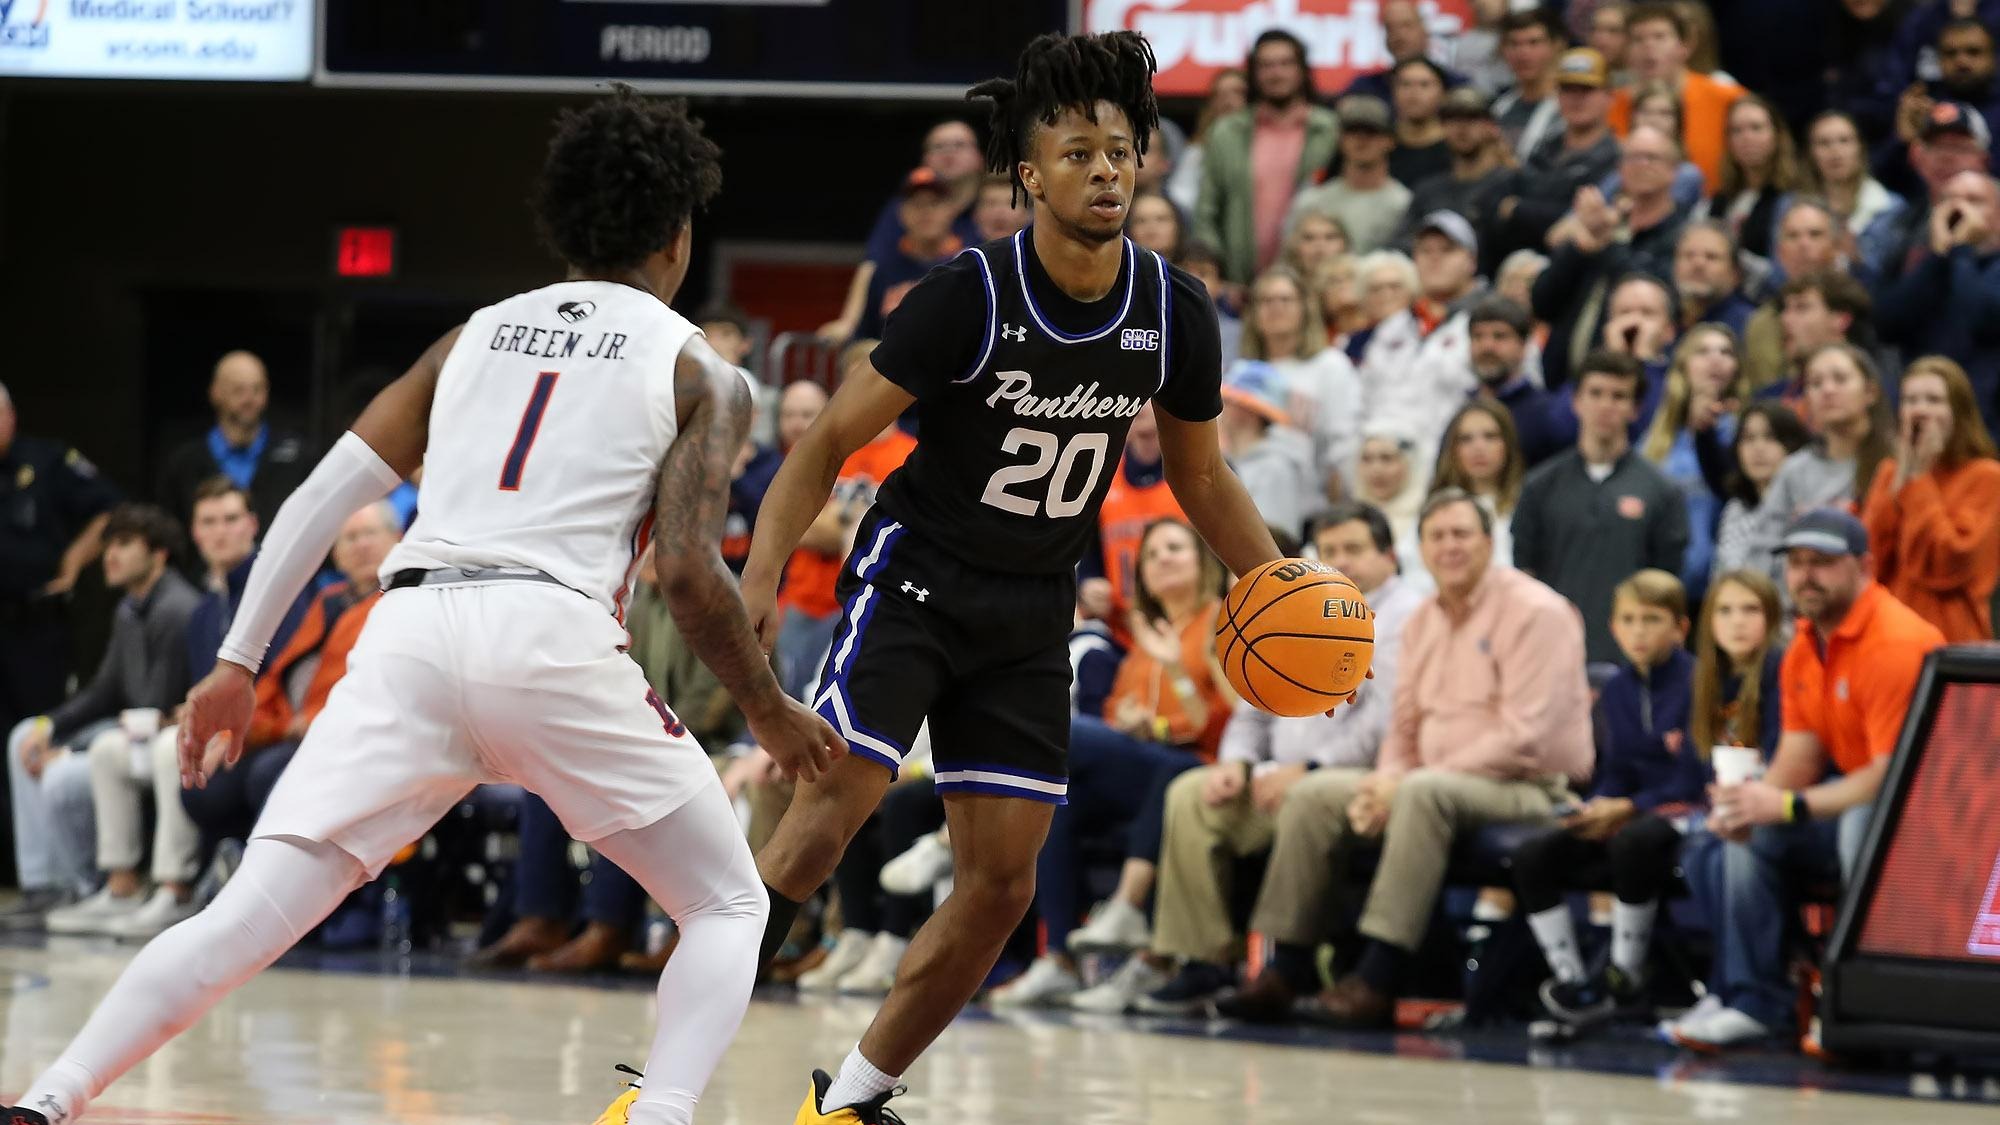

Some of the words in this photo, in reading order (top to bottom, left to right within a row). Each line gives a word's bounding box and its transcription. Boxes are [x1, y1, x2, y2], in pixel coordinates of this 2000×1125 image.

[601, 25, 711, 63] PERIOD
[490, 324, 583, 358] GREEN
[587, 332, 627, 360] JR.
[1121, 328, 1159, 351] SBC
[986, 370, 1142, 419] Panthers
[498, 371, 561, 491] 1
[980, 427, 1109, 518] 20
